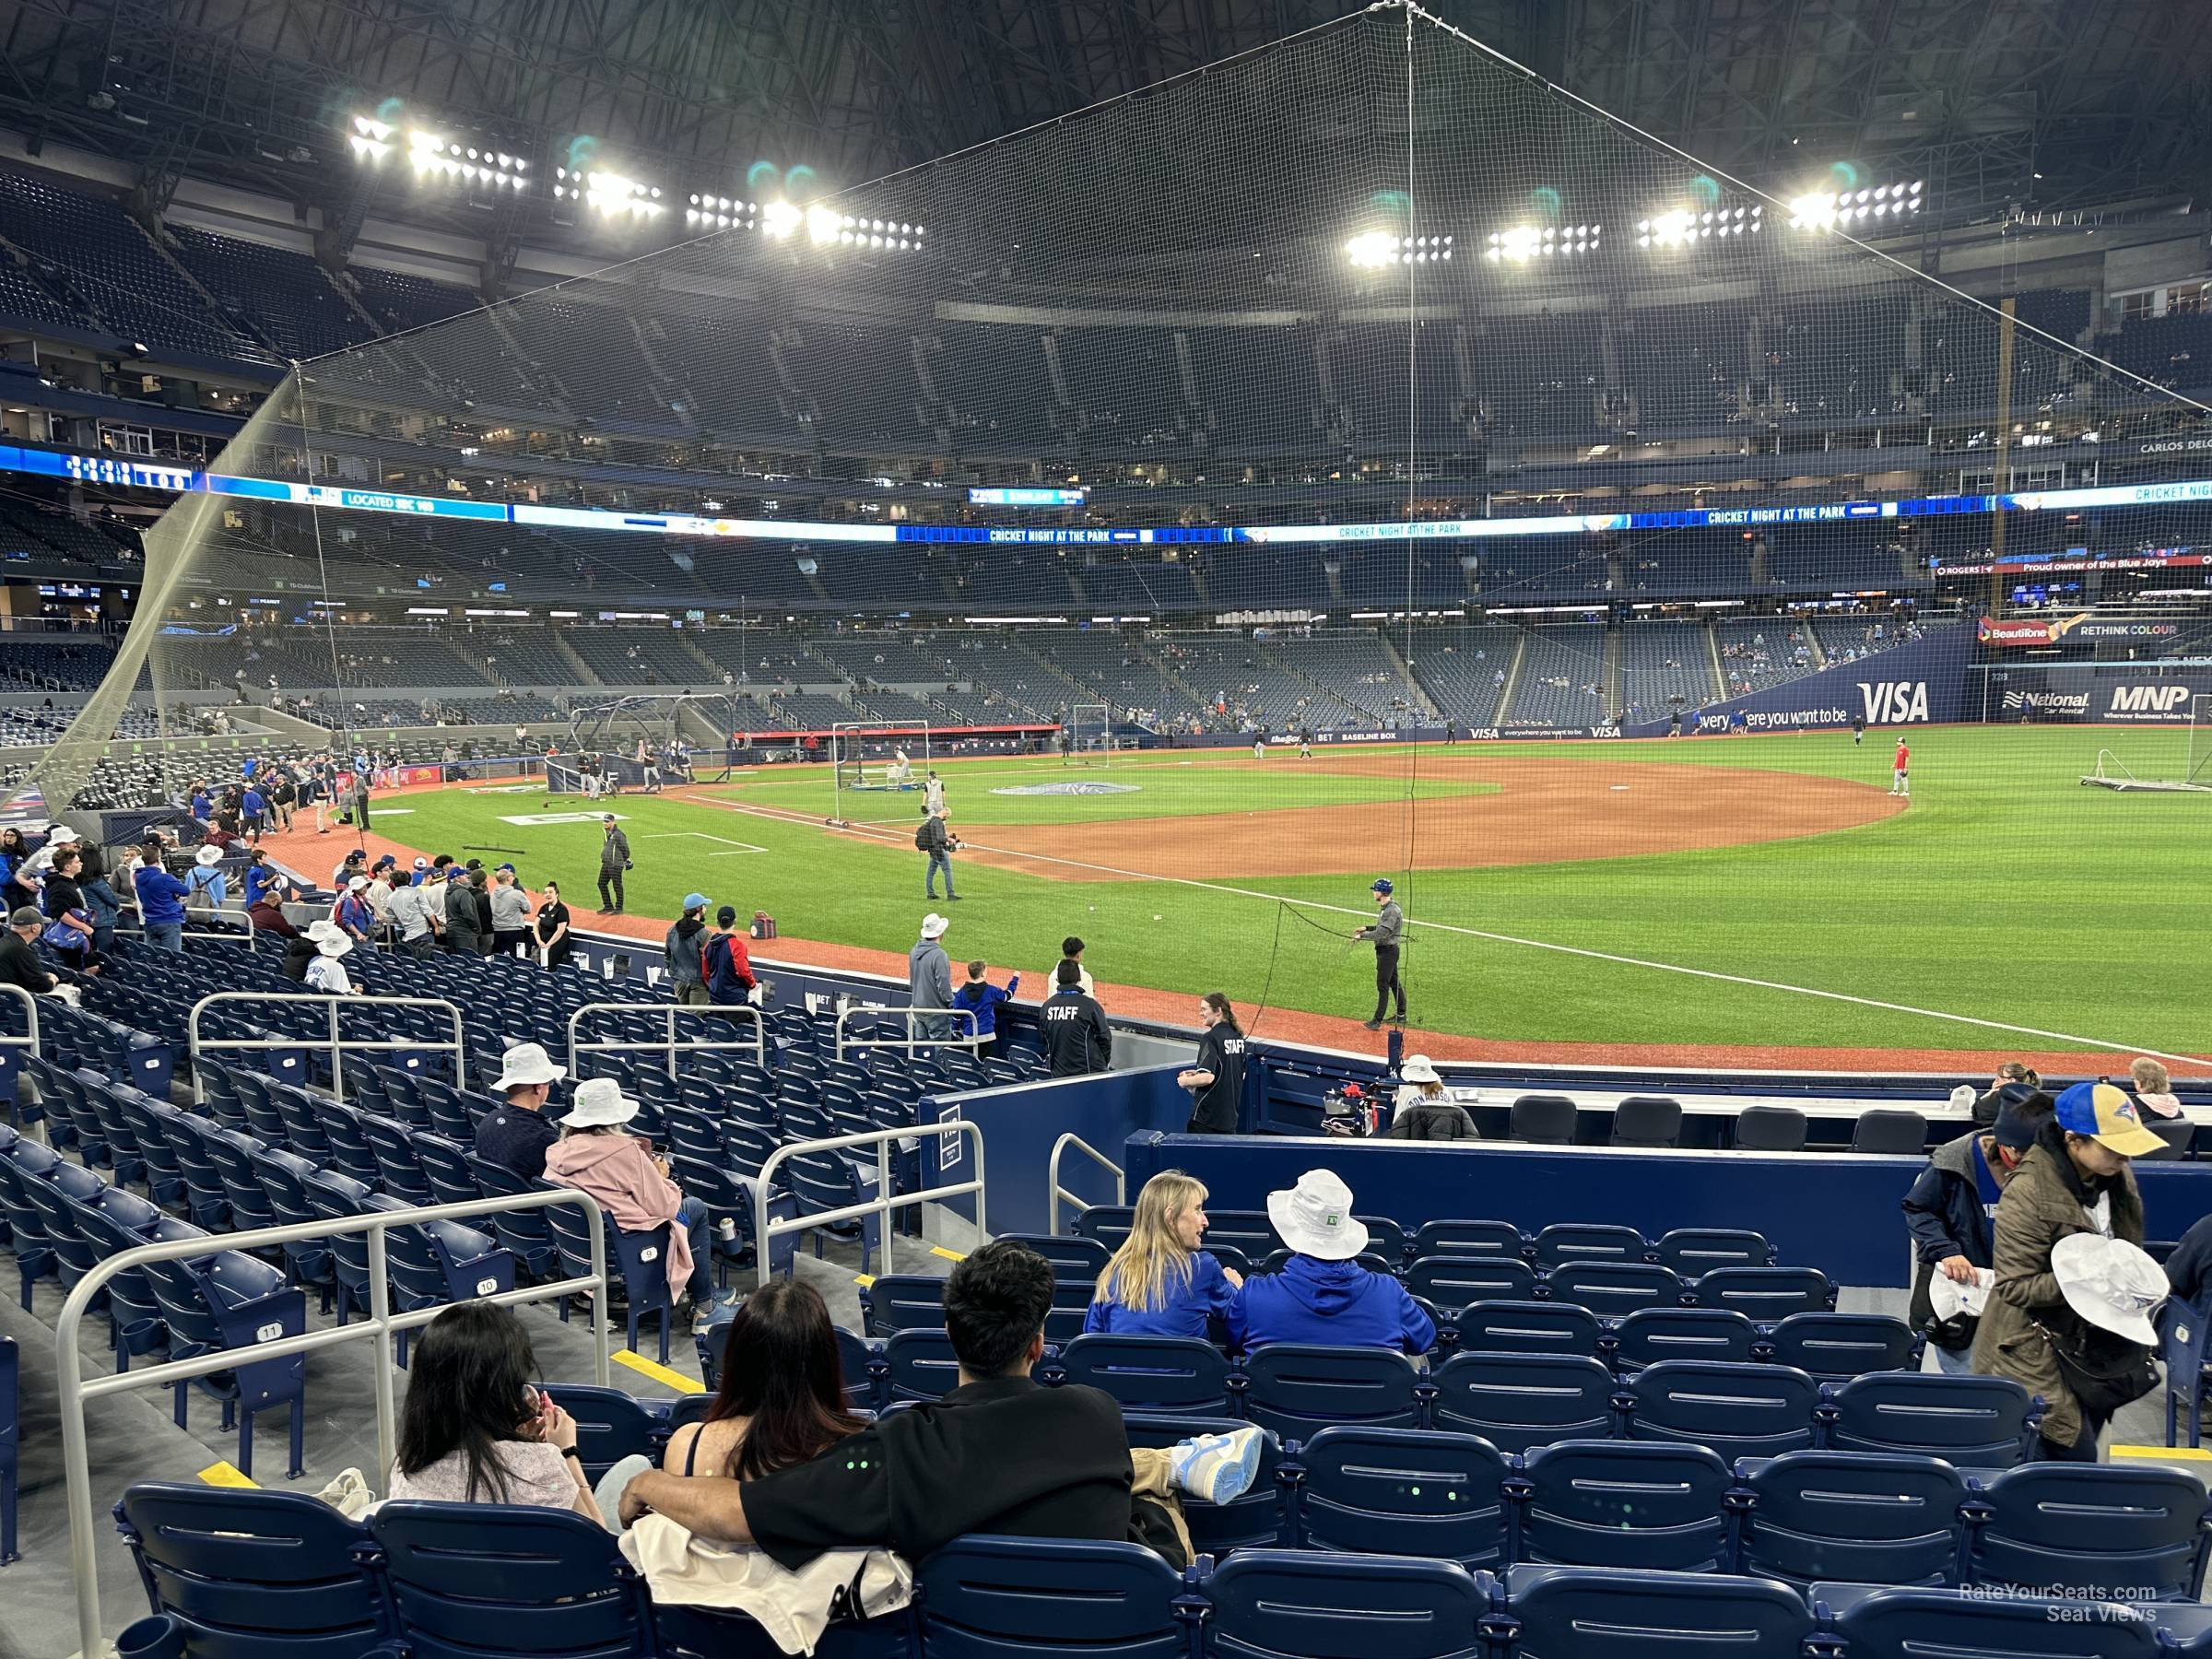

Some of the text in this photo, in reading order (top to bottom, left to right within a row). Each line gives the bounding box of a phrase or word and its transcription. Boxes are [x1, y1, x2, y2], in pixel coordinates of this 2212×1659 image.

[2141, 442, 2183, 453] CARLOS
[2136, 486, 2185, 500] CRICKET
[347, 493, 394, 509] LOCATED
[1708, 510, 1748, 524] CRICKET
[1751, 509, 1781, 523] NIGHT
[1783, 509, 1795, 520] AT
[1797, 508, 1817, 520] THE
[1818, 506, 1846, 518] PARK
[990, 530, 1026, 542] CRICKET
[1028, 530, 1054, 542] NIGHT
[1056, 530, 1067, 542] AT
[1069, 530, 1085, 542] THE
[1087, 530, 1110, 542] PARK
[1339, 526, 1375, 537] CRICKET
[1379, 525, 1404, 536] NIGHT
[1420, 524, 1435, 535] THE
[1439, 524, 1462, 534] PARK
[1947, 566, 1980, 574] ROGERS
[2023, 558, 2168, 572] Proud owner of the Blue Jays
[1992, 628, 2047, 639] BeautiTone
[2080, 625, 2177, 636] RETHINK COLOUR
[1856, 681, 1929, 724] VISA
[2111, 686, 2189, 711] MNP
[1767, 714, 1789, 729] you
[1790, 711, 1818, 724] wnt
[1819, 710, 1831, 724] to
[1833, 706, 1847, 722] be
[1317, 734, 1334, 742] BET
[1341, 733, 1379, 741] BASELINE
[1469, 728, 1500, 739] VISA
[1589, 726, 1621, 737] VISA
[817, 994, 830, 1006] BET
[1047, 1006, 1078, 1021] STAFF
[646, 1250, 653, 1258] 9
[482, 1281, 493, 1291] 10
[264, 1325, 276, 1337] 11
